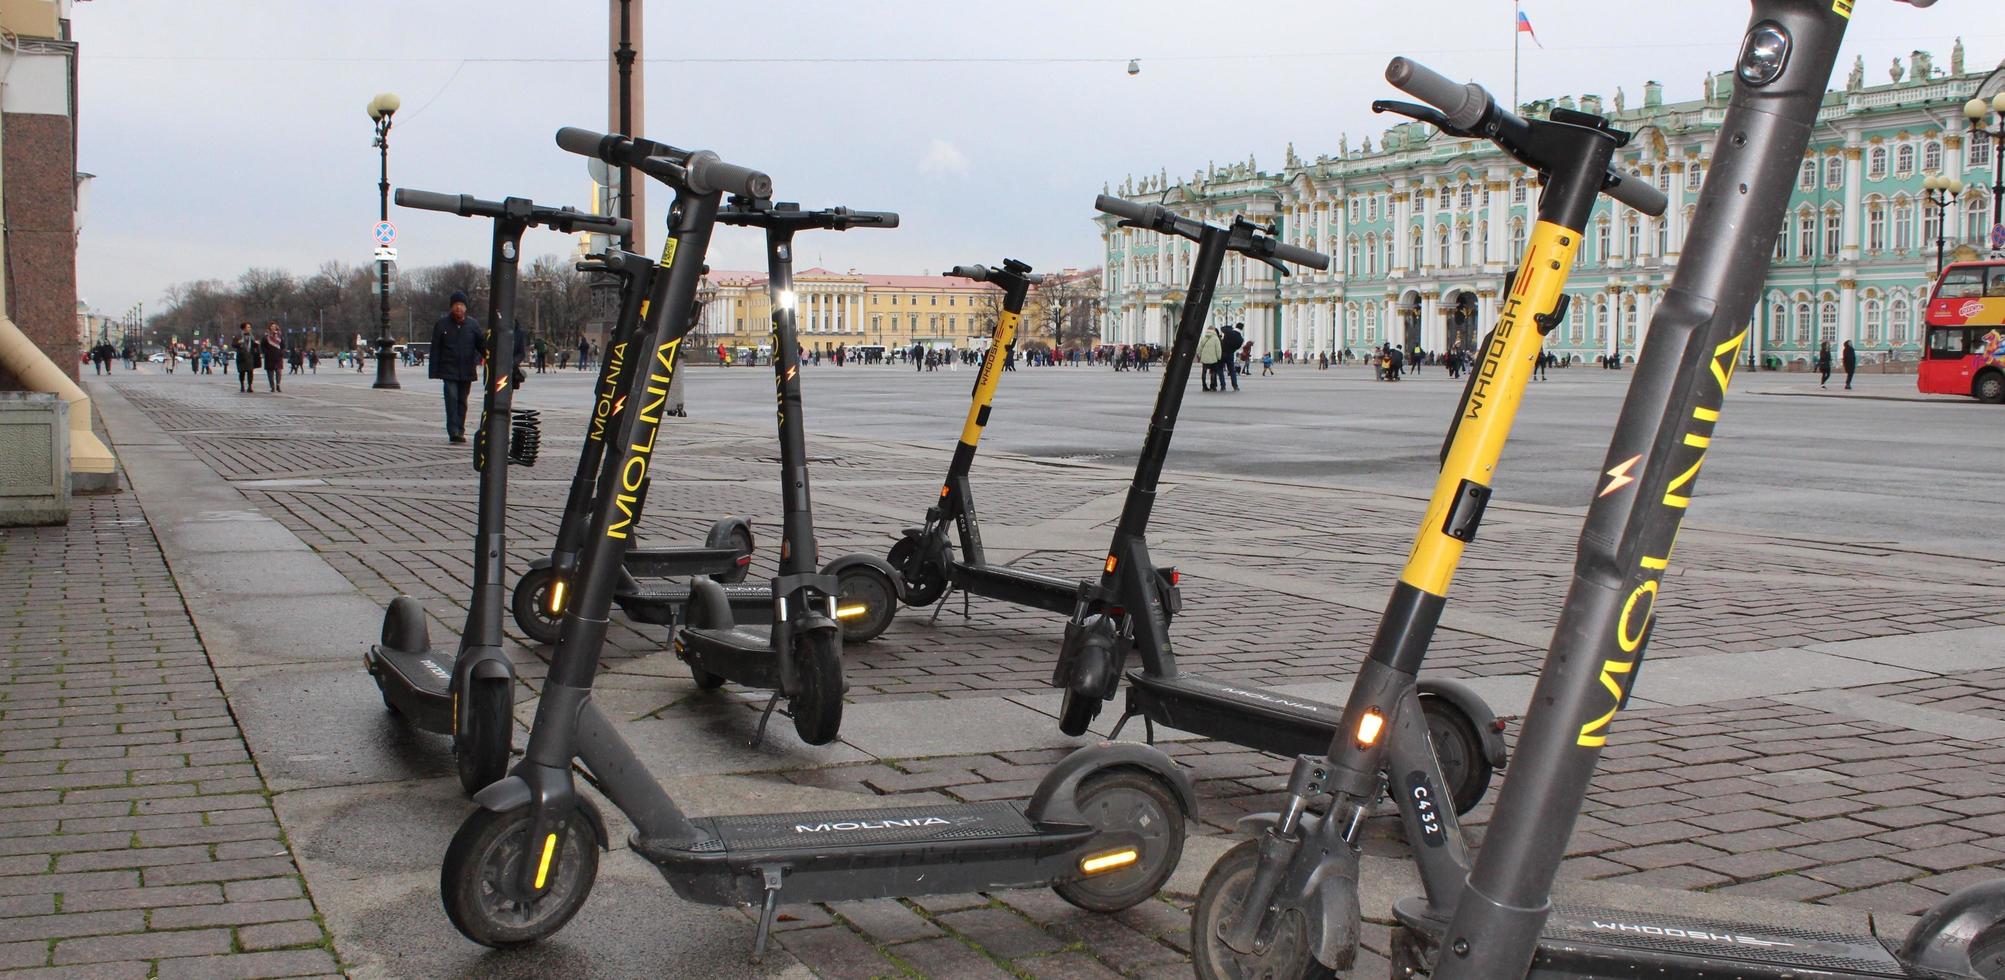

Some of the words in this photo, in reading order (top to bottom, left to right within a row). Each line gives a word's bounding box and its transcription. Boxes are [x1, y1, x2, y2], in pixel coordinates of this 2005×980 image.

[590, 342, 629, 441] MOLNIA
[980, 339, 1001, 386] WHOOSH
[1466, 298, 1521, 420] WHOOSH
[606, 336, 682, 539] MOLNIA
[1576, 326, 1750, 747] MOLNIA
[795, 816, 951, 833] MOLNIA
[1413, 786, 1440, 835] C432
[1592, 920, 1734, 943] WHOOSH
